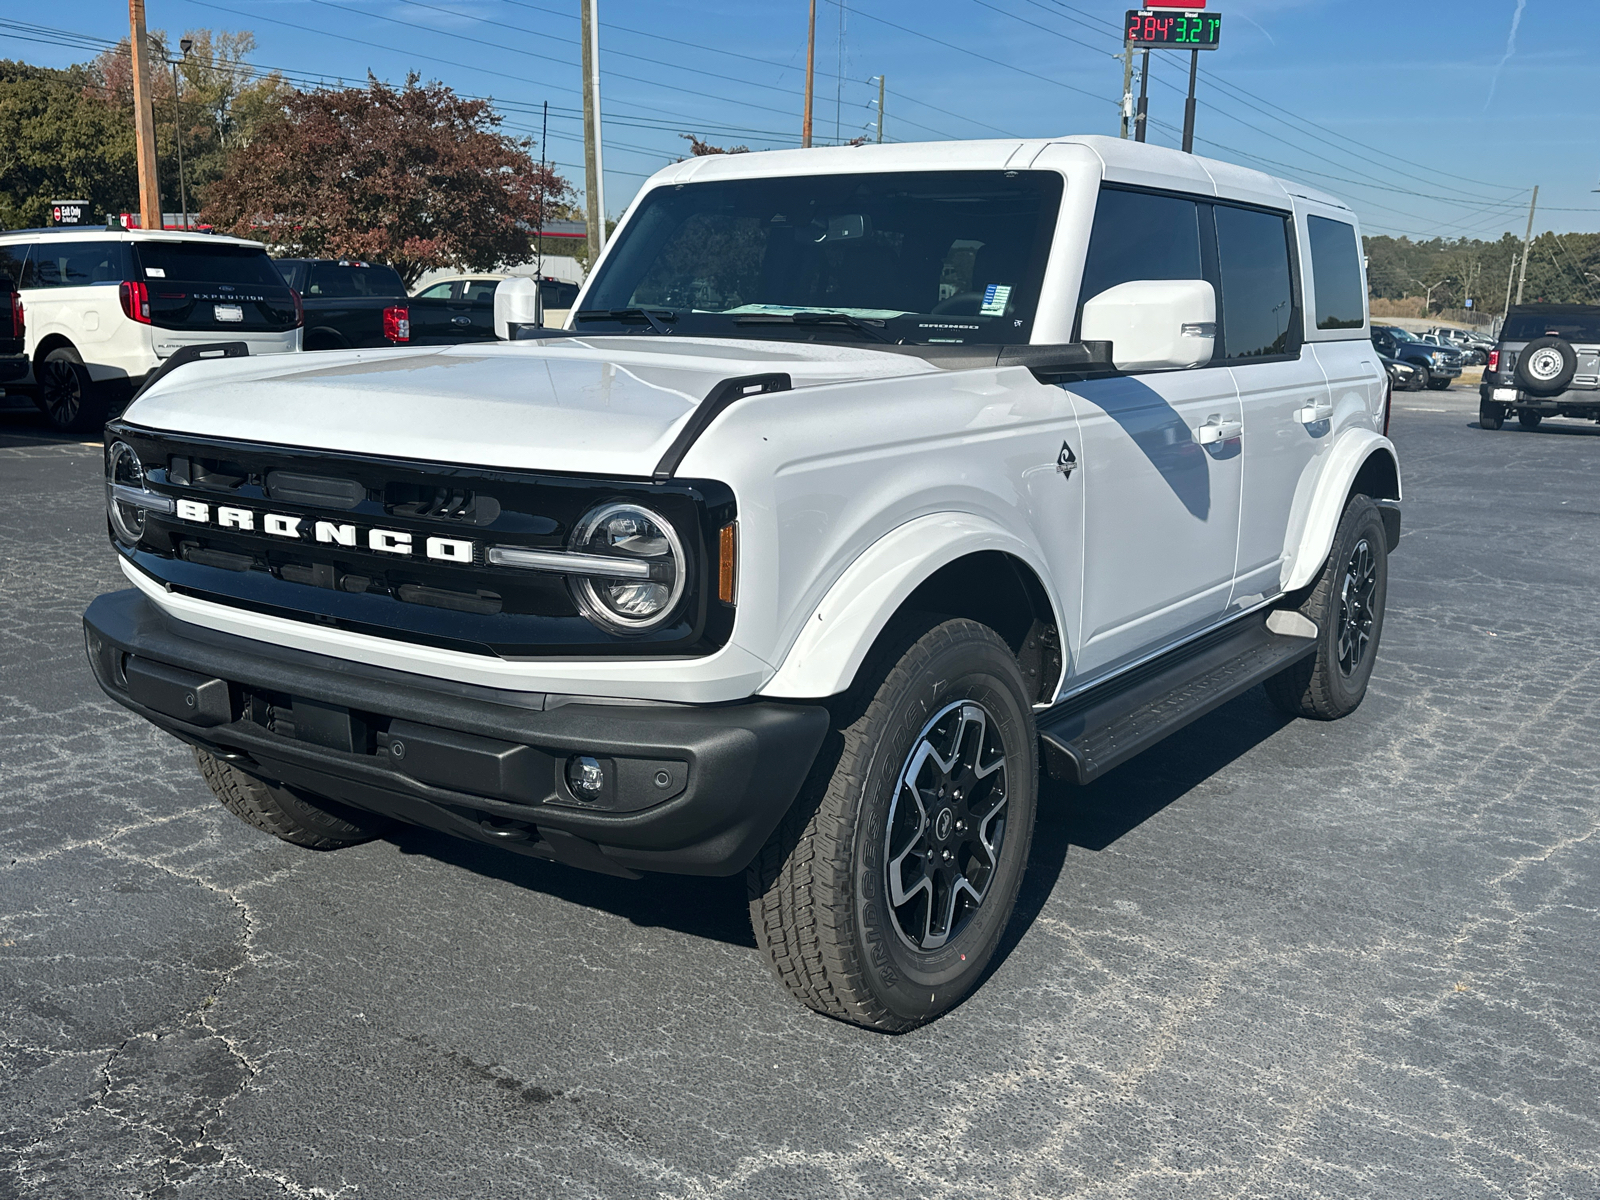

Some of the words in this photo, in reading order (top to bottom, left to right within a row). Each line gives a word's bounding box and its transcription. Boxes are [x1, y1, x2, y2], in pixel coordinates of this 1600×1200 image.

[61, 206, 70, 216] Exit
[71, 206, 81, 218] Only
[193, 293, 264, 301] EXPEDITION
[176, 499, 473, 563] BRONCO
[862, 701, 918, 989] BRIDGESTONE
